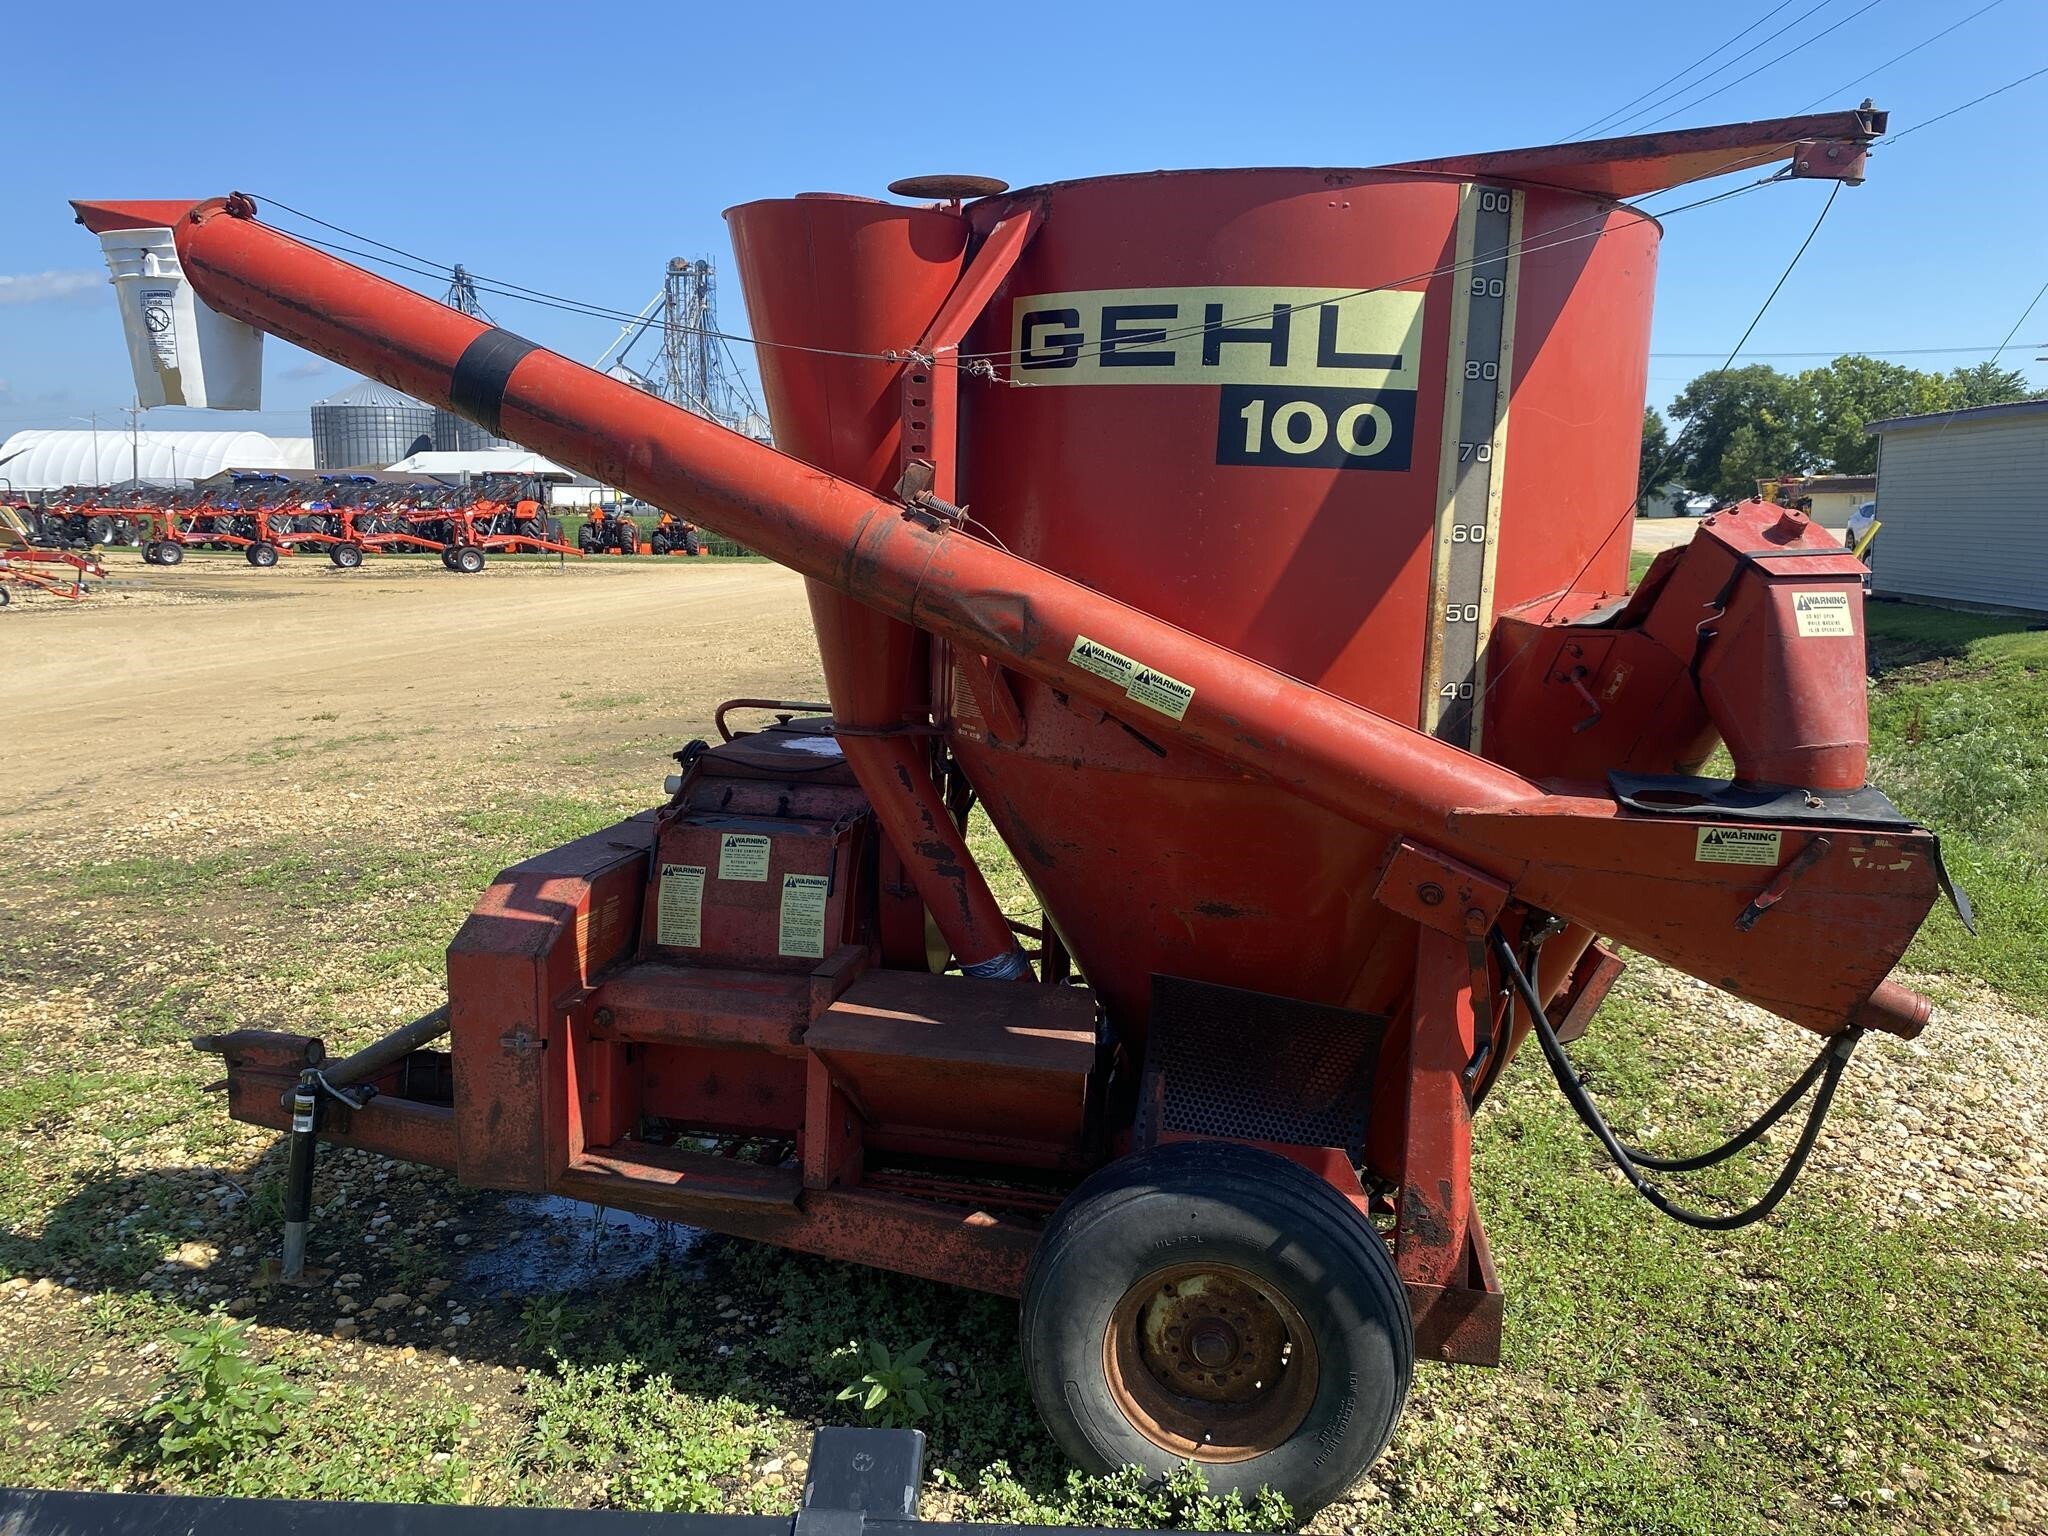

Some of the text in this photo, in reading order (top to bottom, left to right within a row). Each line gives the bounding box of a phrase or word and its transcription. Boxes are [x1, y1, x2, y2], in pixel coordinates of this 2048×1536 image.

[1471, 277, 1504, 298] 90
[1020, 303, 1403, 371] GEHL
[1464, 360, 1498, 381] 80
[1240, 399, 1393, 457] 100
[1458, 443, 1492, 463] 70
[1451, 523, 1486, 543] 60
[1806, 596, 1847, 605] WARNING
[1445, 603, 1479, 622] 50
[1091, 645, 1133, 671] WARNING
[1150, 672, 1192, 698] WARNING
[1439, 682, 1475, 700] 40
[735, 837, 768, 845] WARNING
[1720, 830, 1777, 842] WARNING
[672, 865, 704, 875] WARNING
[795, 877, 828, 886] WARNING
